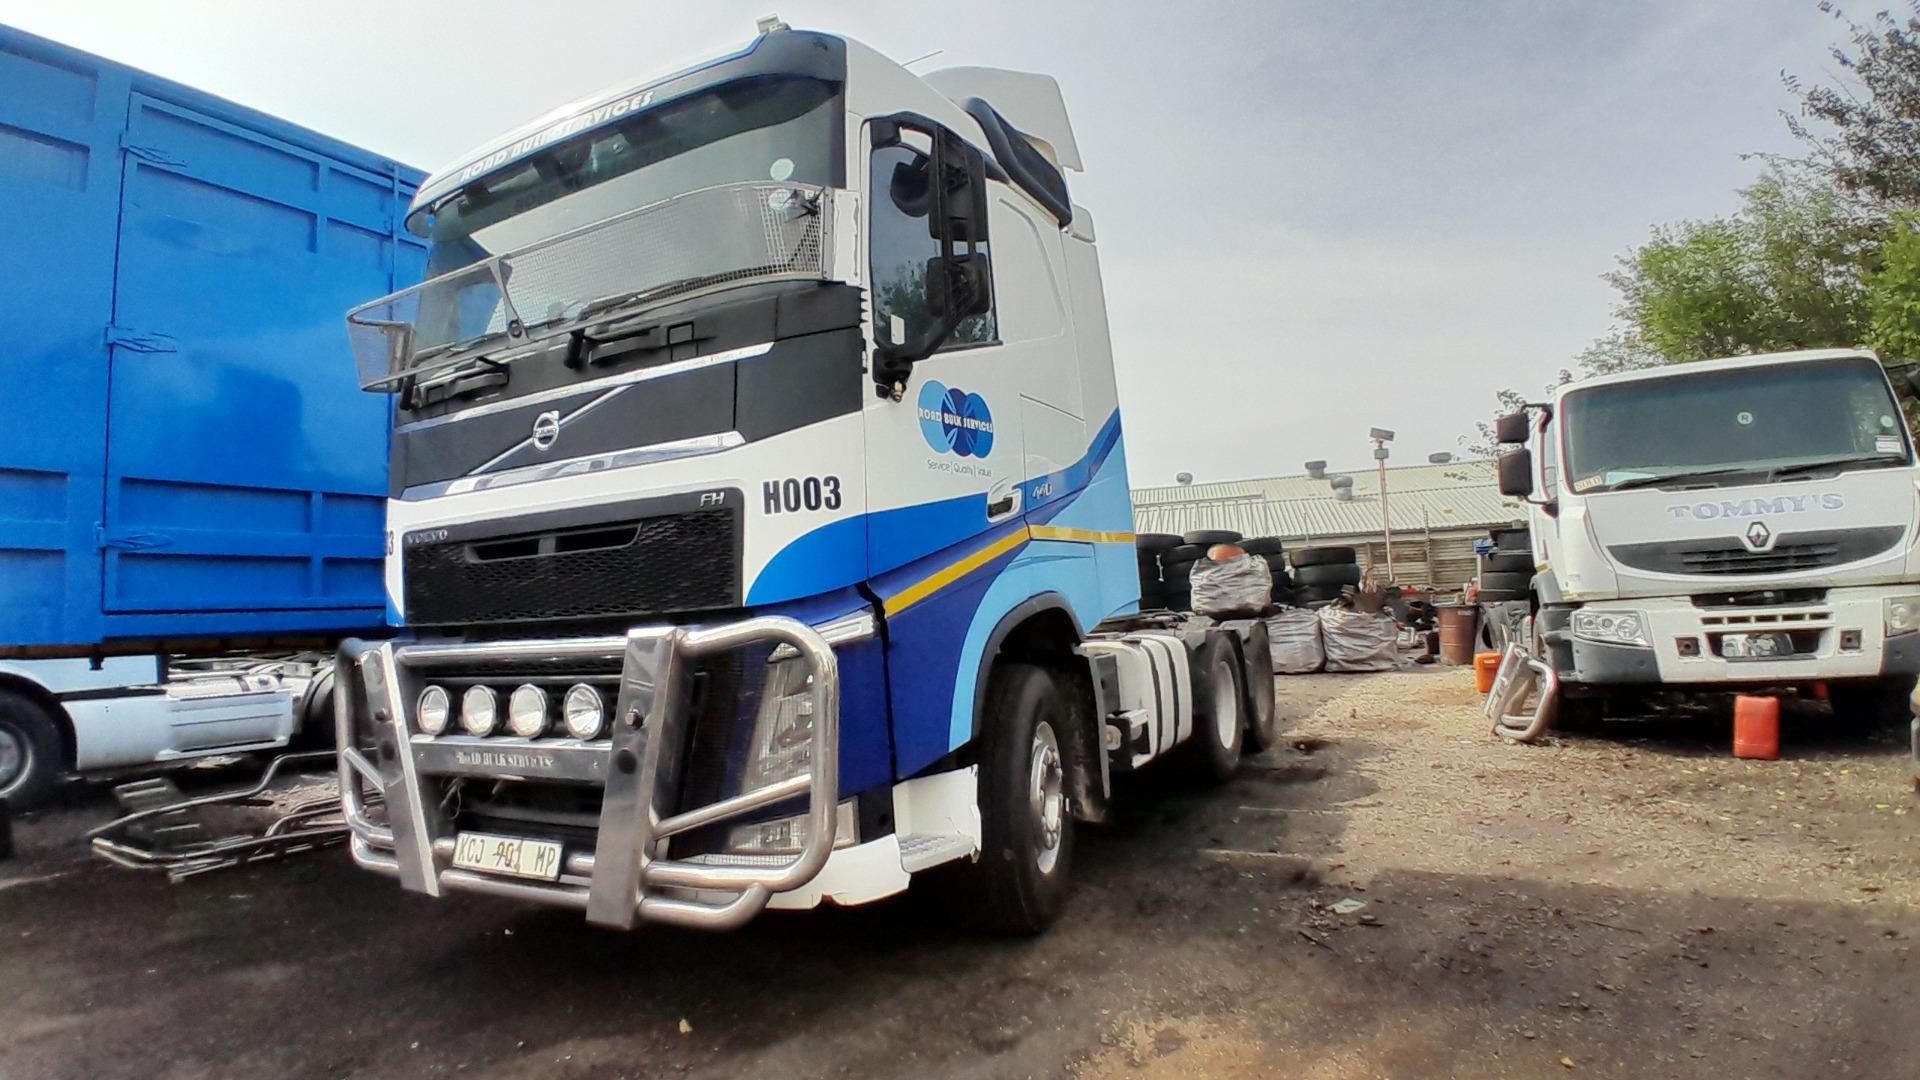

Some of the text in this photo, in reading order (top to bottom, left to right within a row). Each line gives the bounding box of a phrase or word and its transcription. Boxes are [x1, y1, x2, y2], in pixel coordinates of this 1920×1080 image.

[918, 408, 942, 421] ROAD
[944, 413, 962, 427] BULK
[700, 491, 725, 507] FH
[763, 475, 842, 515] H003
[1667, 493, 1844, 519] TOMMY'S
[405, 529, 448, 544] VOLVO
[457, 836, 485, 864] KCJ
[534, 845, 556, 876] MP
